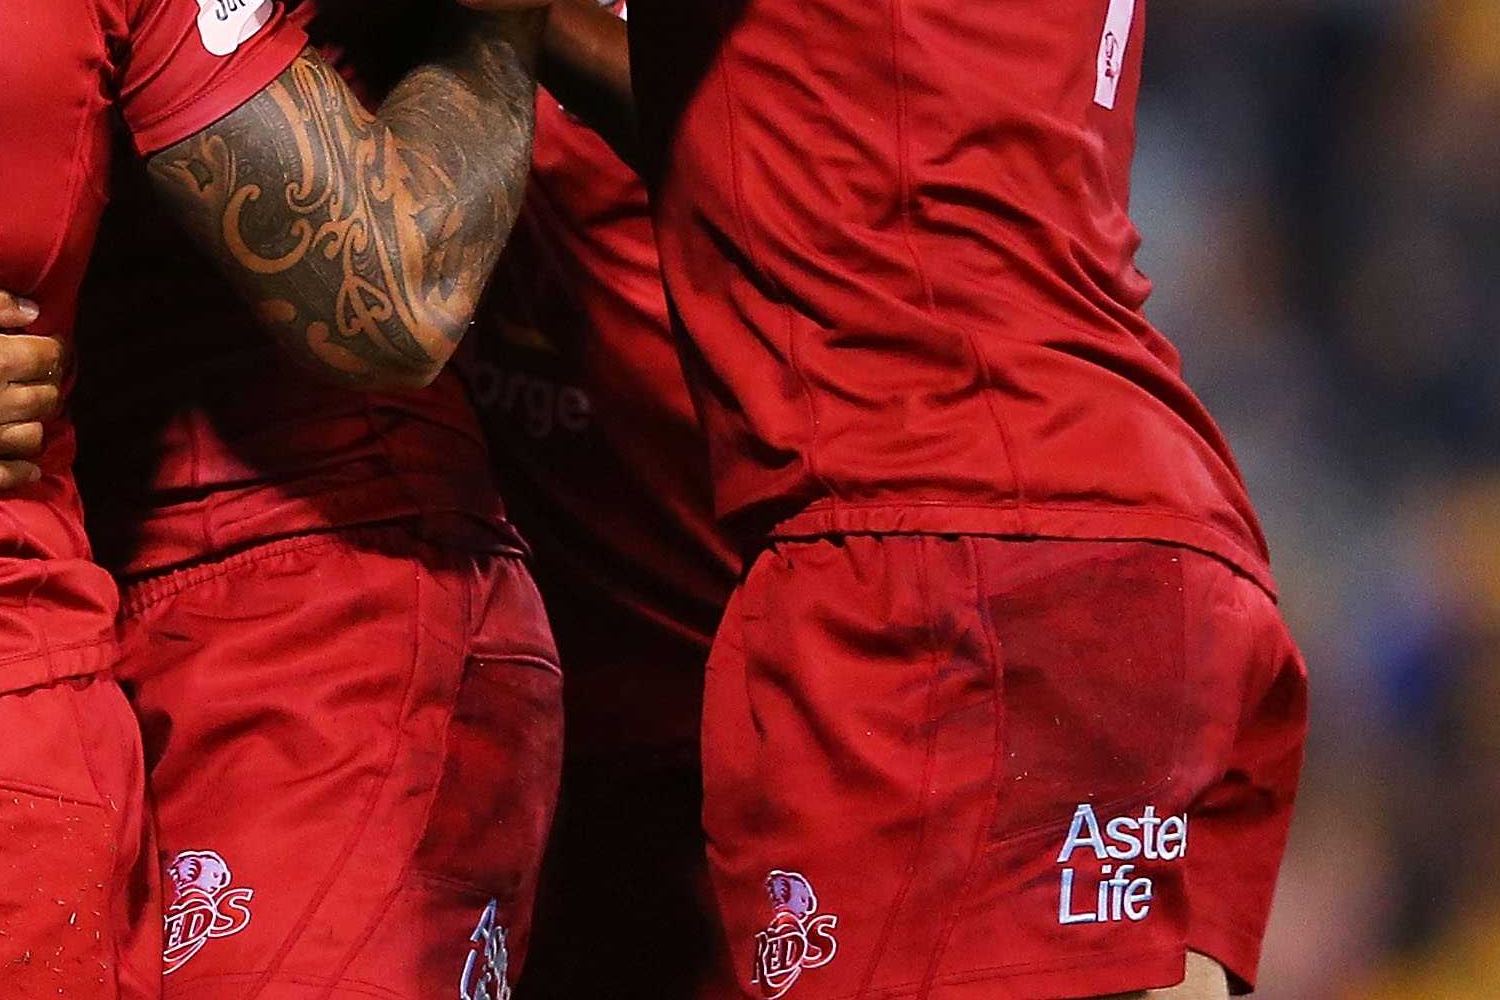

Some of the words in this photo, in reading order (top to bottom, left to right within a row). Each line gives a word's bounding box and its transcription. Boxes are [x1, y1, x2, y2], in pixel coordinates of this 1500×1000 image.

[466, 361, 593, 440] orge
[162, 886, 254, 957] EDS
[1058, 864, 1154, 924] Life
